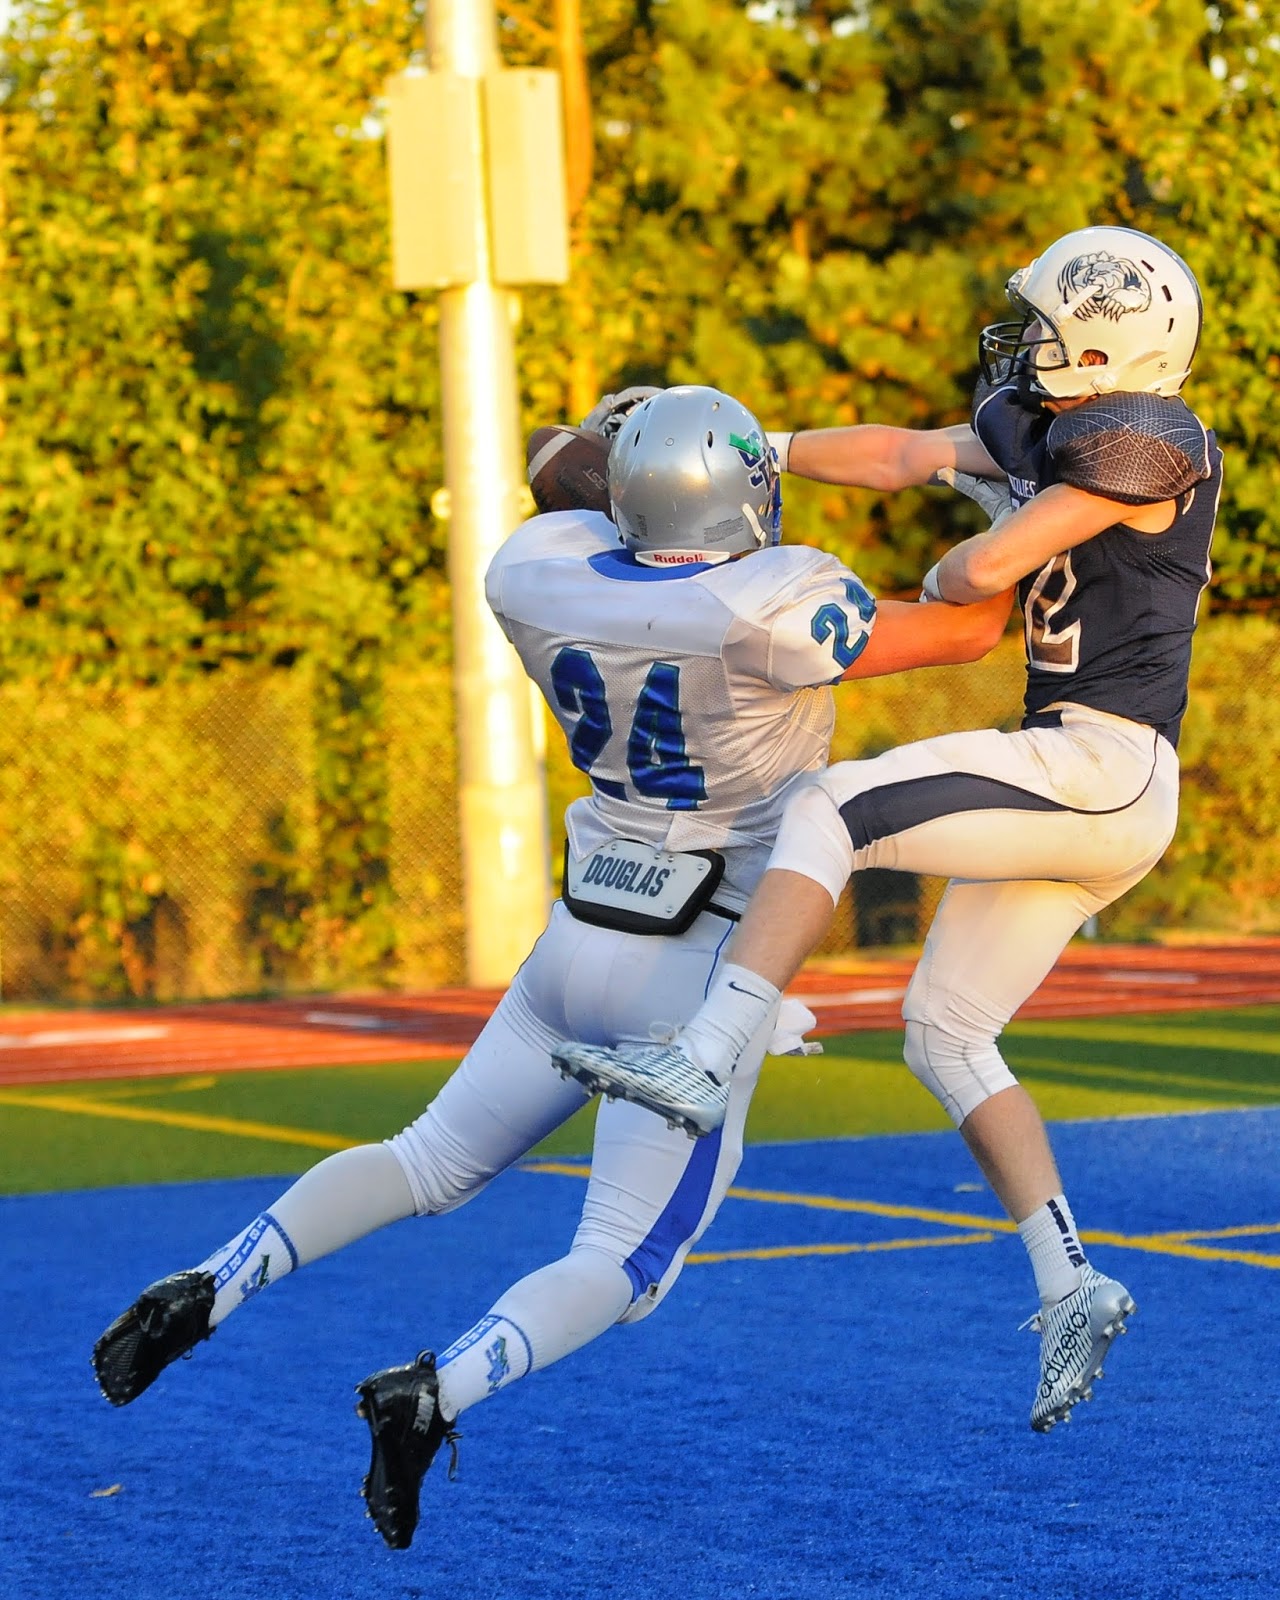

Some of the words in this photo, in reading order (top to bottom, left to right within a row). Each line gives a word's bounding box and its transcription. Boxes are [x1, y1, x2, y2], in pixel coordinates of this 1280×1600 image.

[653, 553, 704, 564] Riddell
[550, 646, 709, 812] 24
[581, 854, 671, 898] DOUGLAS
[1041, 1312, 1087, 1399] adizero
